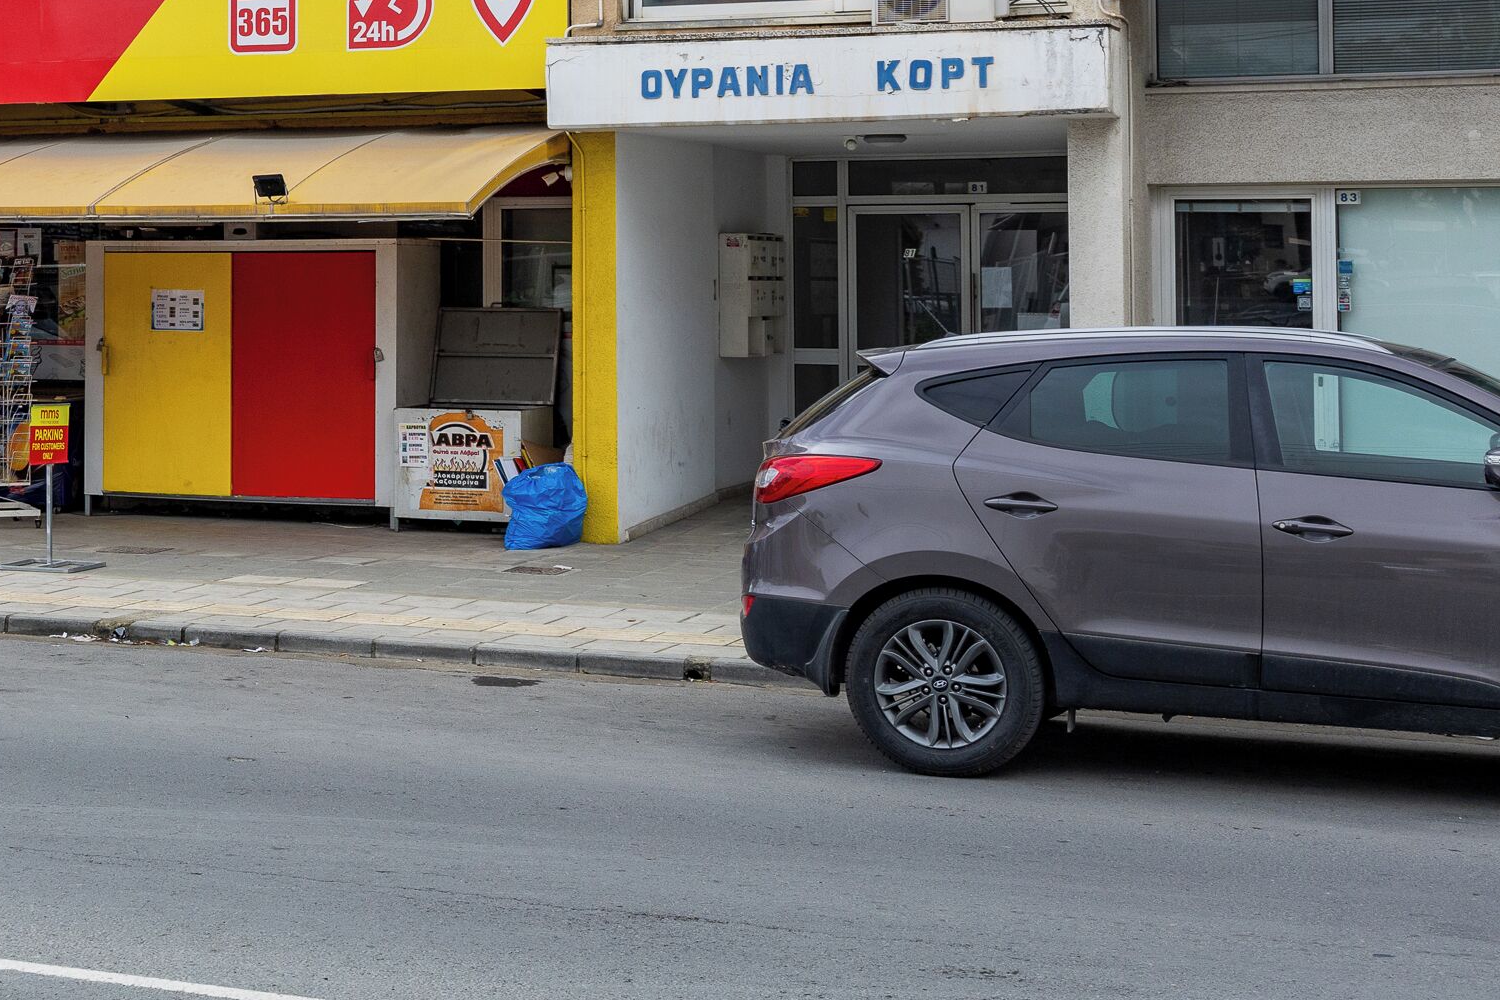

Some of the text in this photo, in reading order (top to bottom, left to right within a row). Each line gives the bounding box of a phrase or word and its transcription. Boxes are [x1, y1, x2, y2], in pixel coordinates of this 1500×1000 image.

[238, 7, 288, 37] 365
[353, 20, 395, 42] 24h
[641, 56, 995, 100] ΟΥΡΑΝΙΑ ΚΟΡΤ
[970, 183, 985, 192] 81
[1340, 192, 1358, 202] 83
[41, 409, 60, 419] mms
[34, 428, 64, 441] PARKING
[32, 442, 65, 450] FOR CUSTOMERS
[42, 452, 53, 460] ONLY
[434, 472, 485, 480] υλοκάρβουνα
